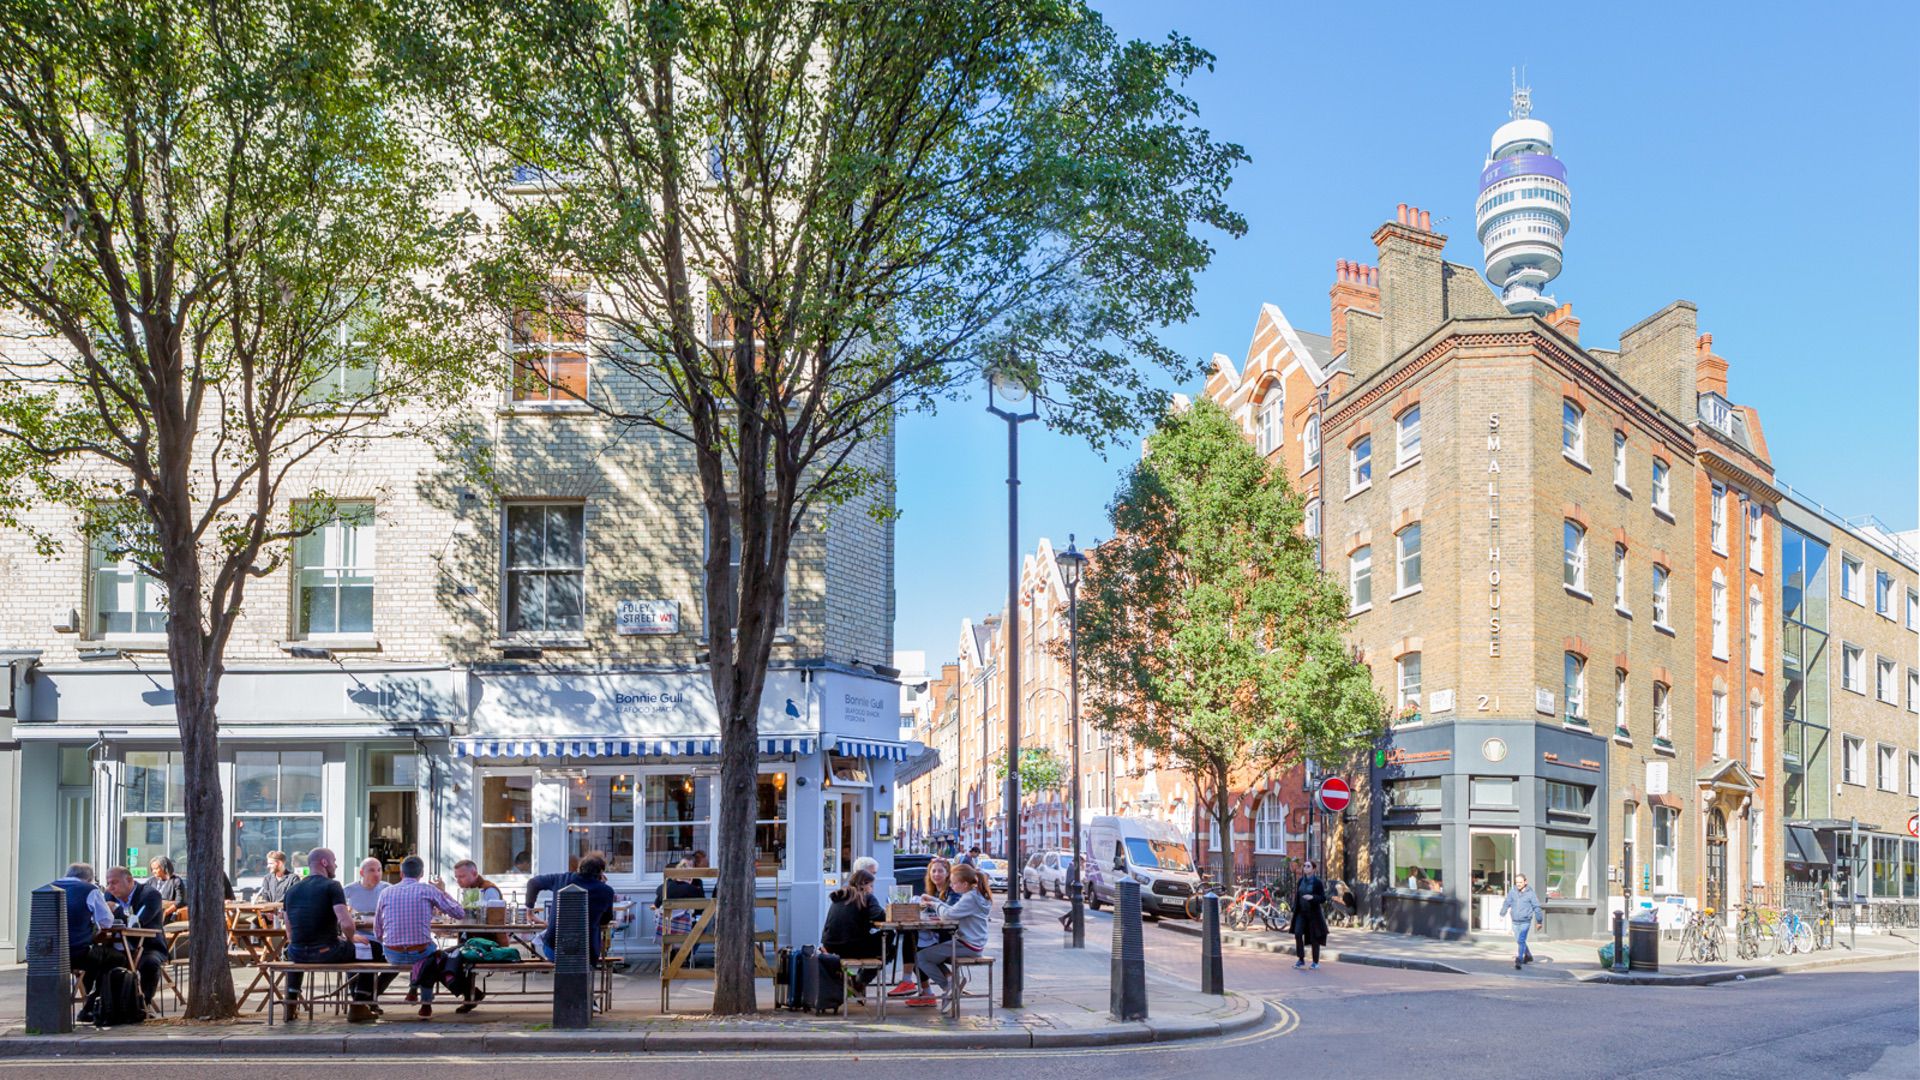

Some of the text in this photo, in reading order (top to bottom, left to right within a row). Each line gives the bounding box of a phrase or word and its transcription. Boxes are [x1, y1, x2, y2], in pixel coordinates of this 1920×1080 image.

[1487, 412, 1500, 657] SMALL HOUSE
[623, 603, 650, 613] FOLEY
[623, 612, 672, 623] STREET W1
[616, 692, 683, 703] Bonnie Gull
[845, 694, 883, 710] Bonnie Gull
[1478, 695, 1500, 712] 21
[1011, 770, 1018, 780] 3
